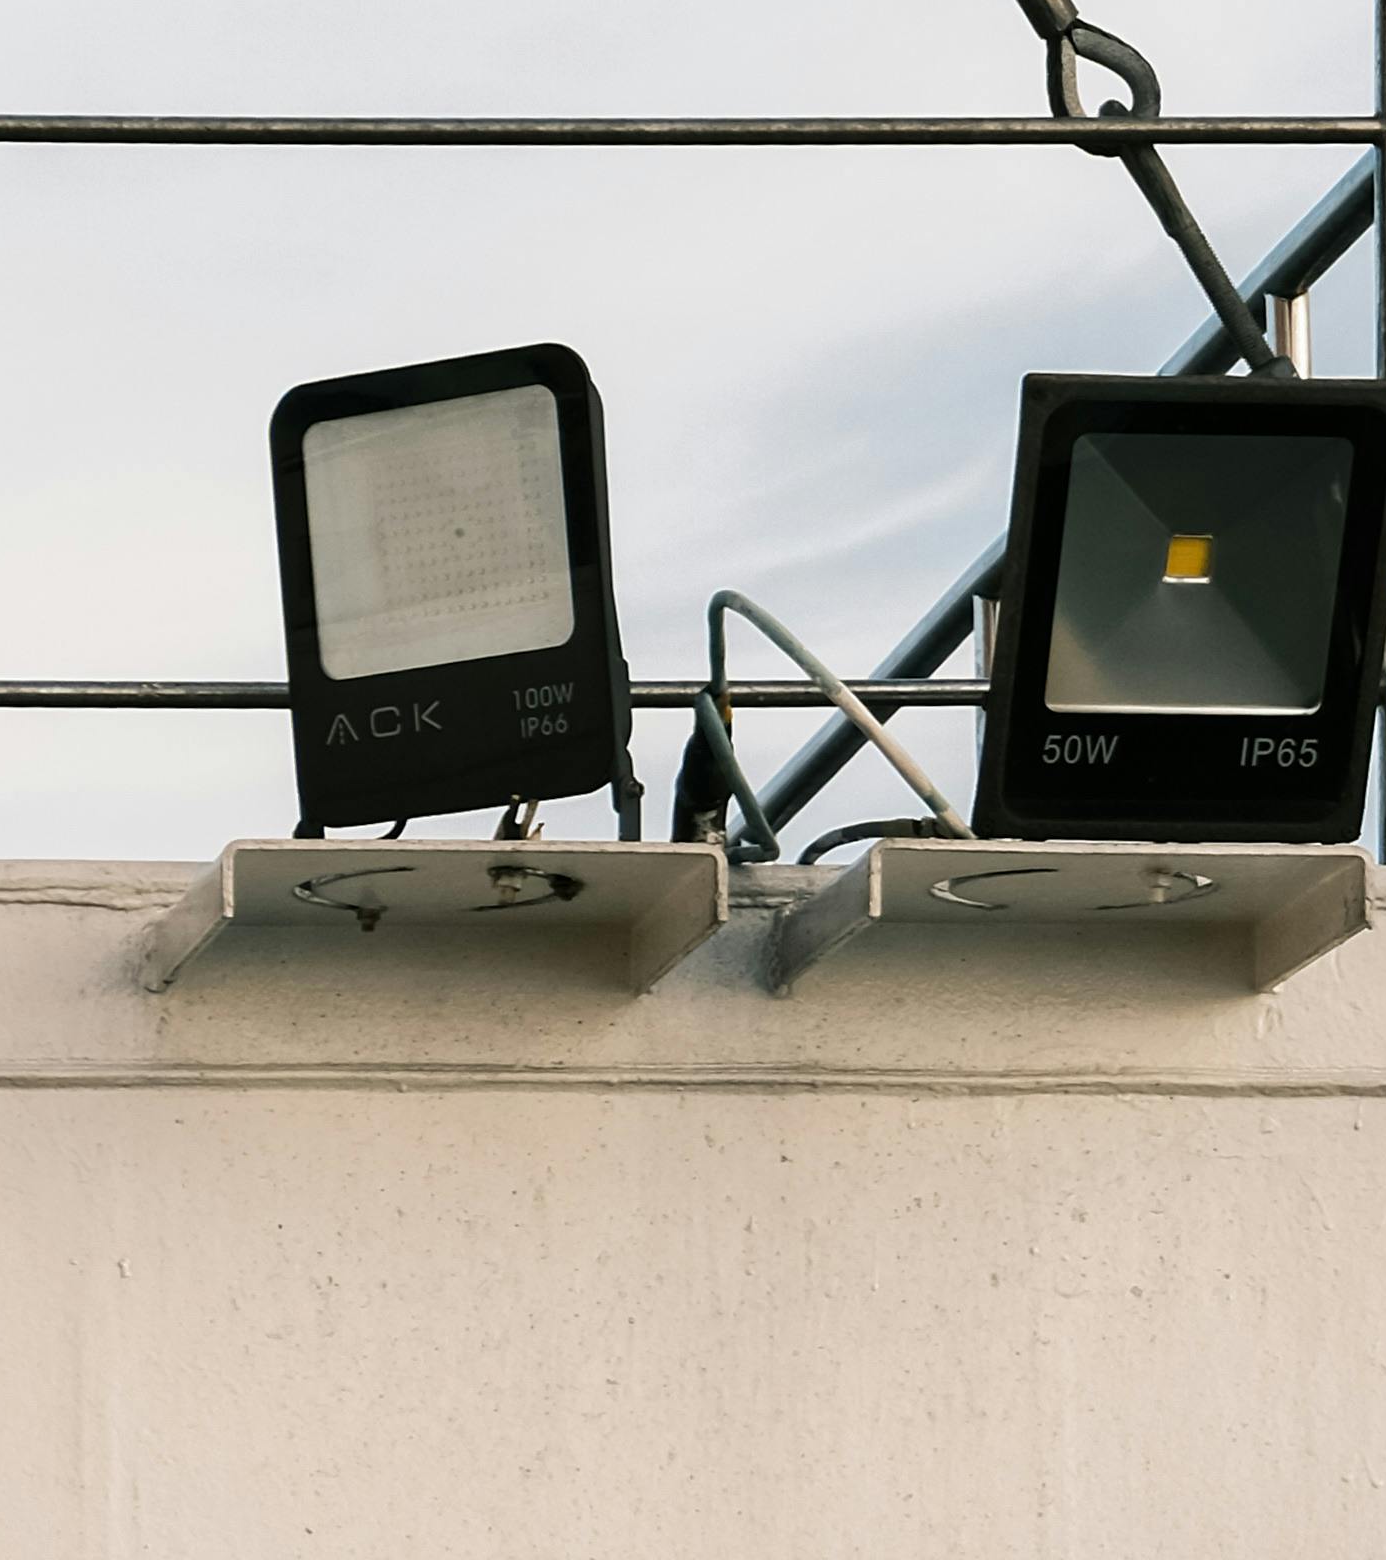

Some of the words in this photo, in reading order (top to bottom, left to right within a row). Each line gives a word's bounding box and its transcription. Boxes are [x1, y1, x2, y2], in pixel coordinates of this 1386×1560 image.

[513, 682, 574, 711] 100W
[326, 700, 442, 745] ACK
[520, 713, 568, 738] IP66
[1042, 734, 1119, 764] 50W
[1240, 737, 1318, 767] IP65
